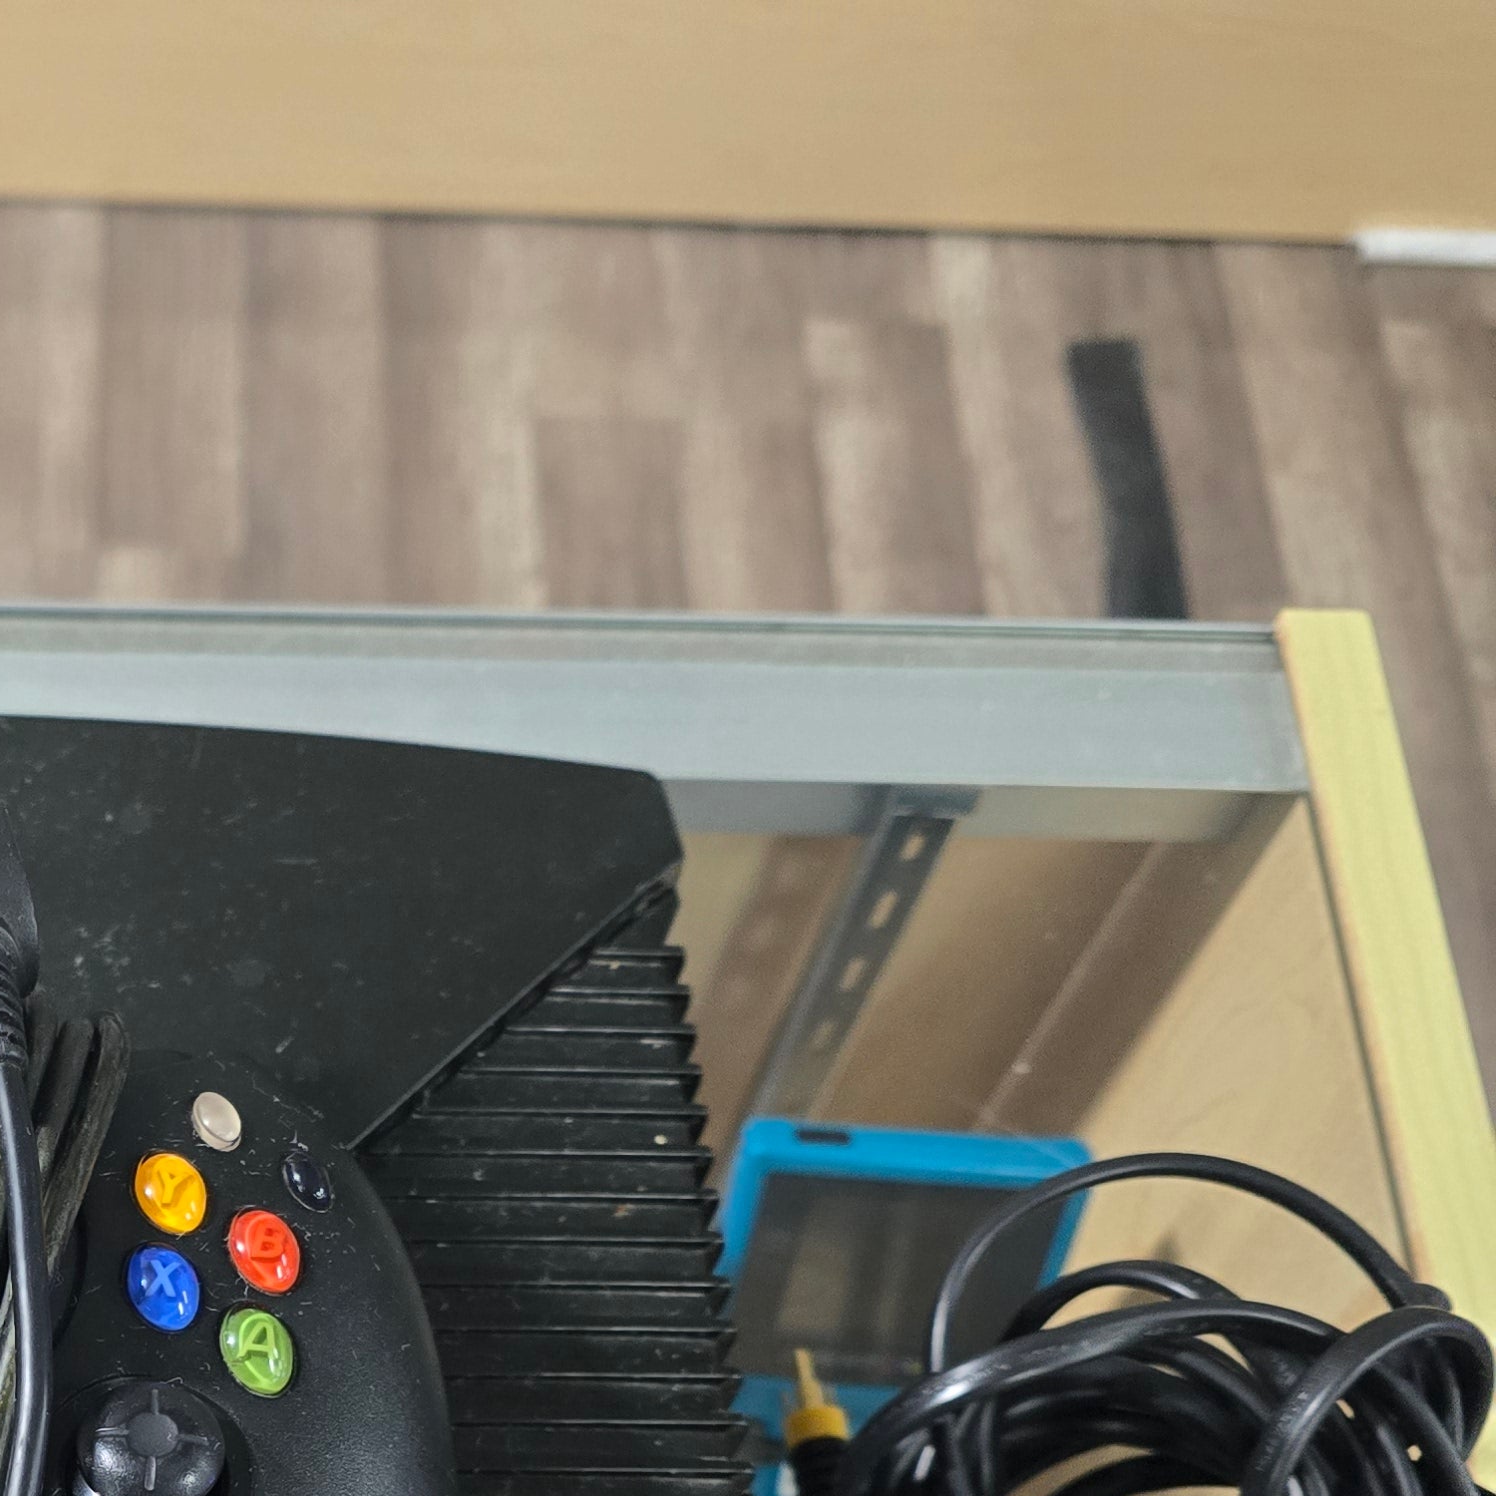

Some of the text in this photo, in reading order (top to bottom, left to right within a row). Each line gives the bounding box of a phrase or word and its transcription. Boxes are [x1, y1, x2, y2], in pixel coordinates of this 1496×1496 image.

[155, 1167, 196, 1208] Y
[248, 1218, 286, 1261] B
[145, 1258, 181, 1298] X
[236, 1320, 278, 1362] A
